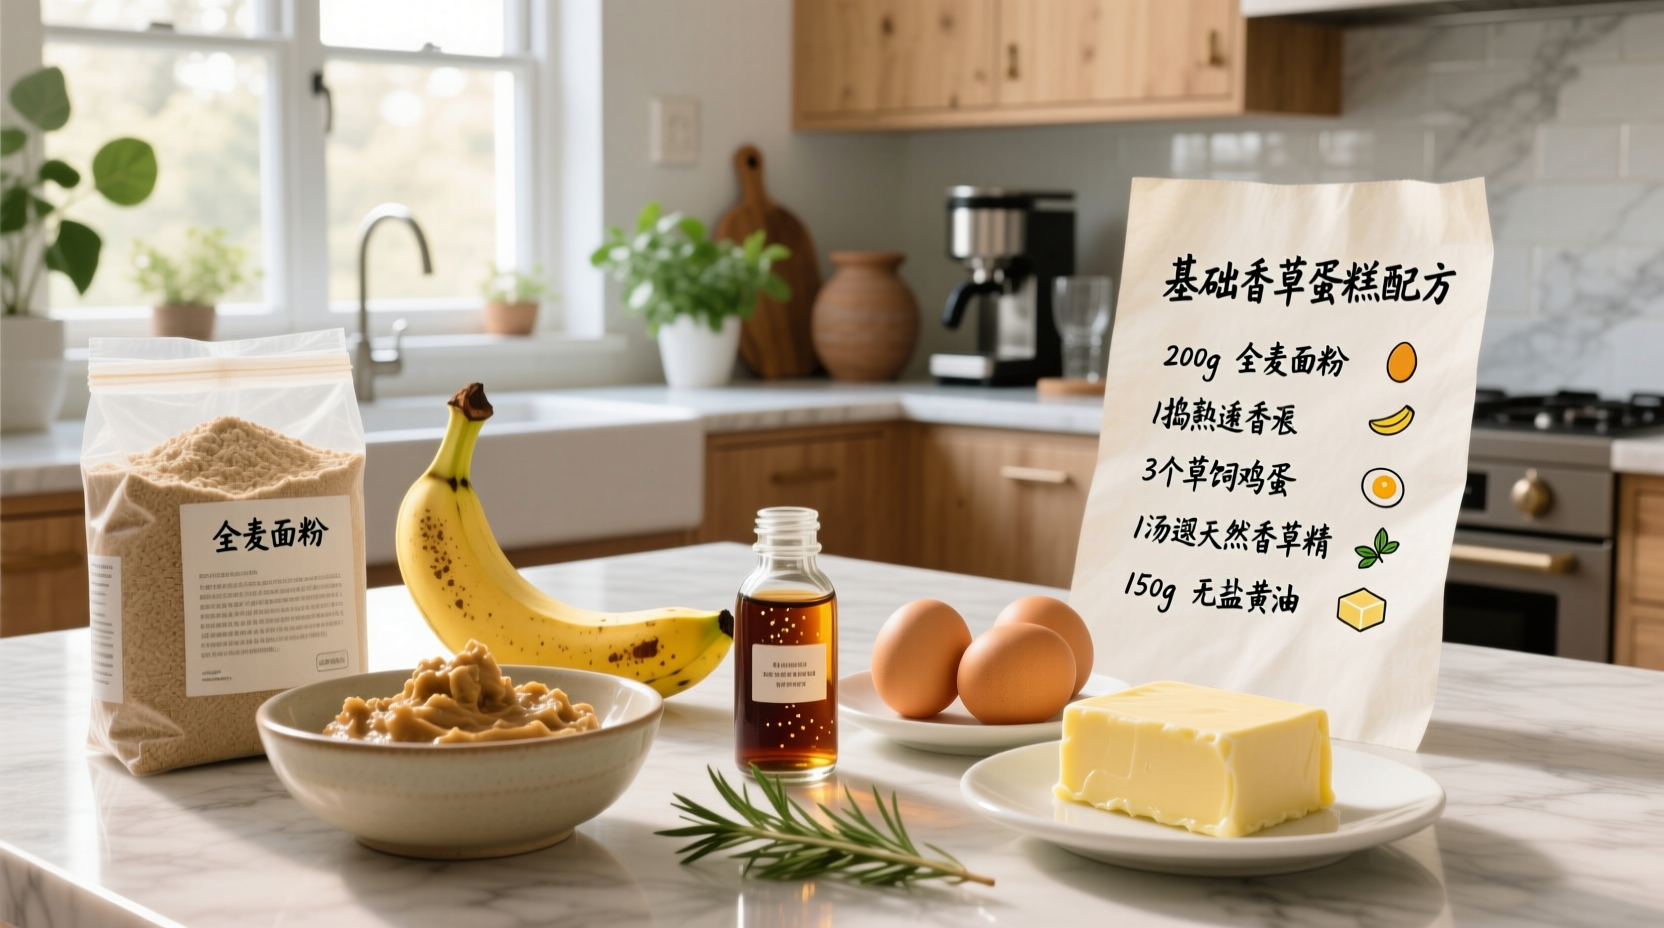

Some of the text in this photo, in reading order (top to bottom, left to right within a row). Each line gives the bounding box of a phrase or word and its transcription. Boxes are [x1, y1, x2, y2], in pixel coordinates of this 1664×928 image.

[1163, 253, 1457, 308] 基础香草蛋糕配方
[1163, 341, 1350, 383] 200g 全麦面粉
[1141, 454, 1297, 498] 3个草饲鸡蛋
[212, 516, 330, 554] 全麦面粉
[1124, 571, 1300, 615] 150g 无盐黄油
